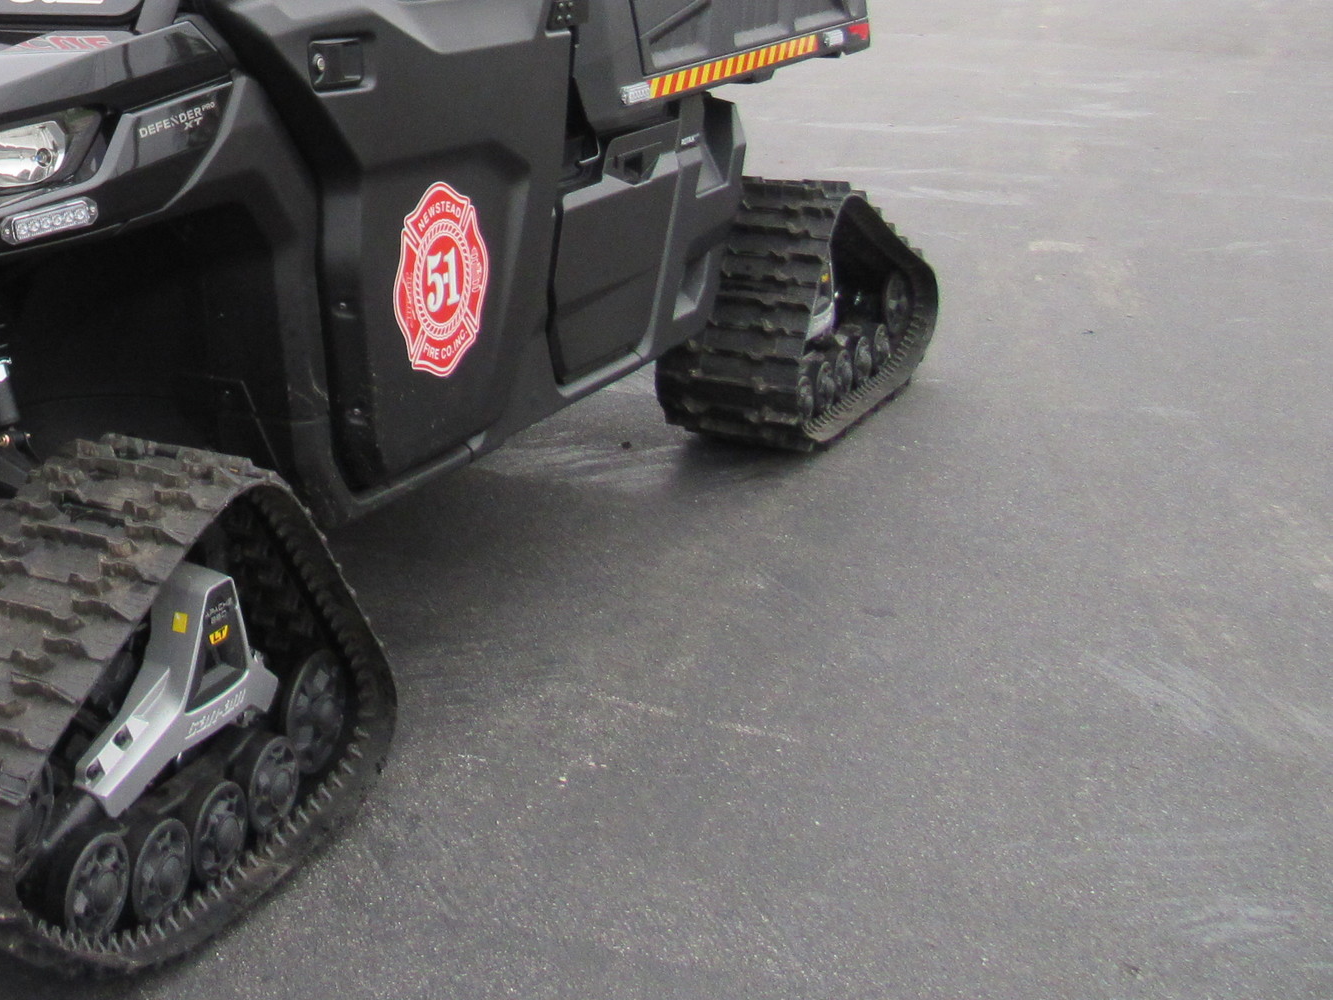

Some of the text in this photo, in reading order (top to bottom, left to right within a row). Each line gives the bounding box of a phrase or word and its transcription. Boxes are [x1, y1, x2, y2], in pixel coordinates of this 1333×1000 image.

[138, 107, 203, 138] DEFENDER
[184, 117, 203, 130] XT
[418, 200, 462, 232] NEWSTEAD
[423, 342, 440, 360] FIRE
